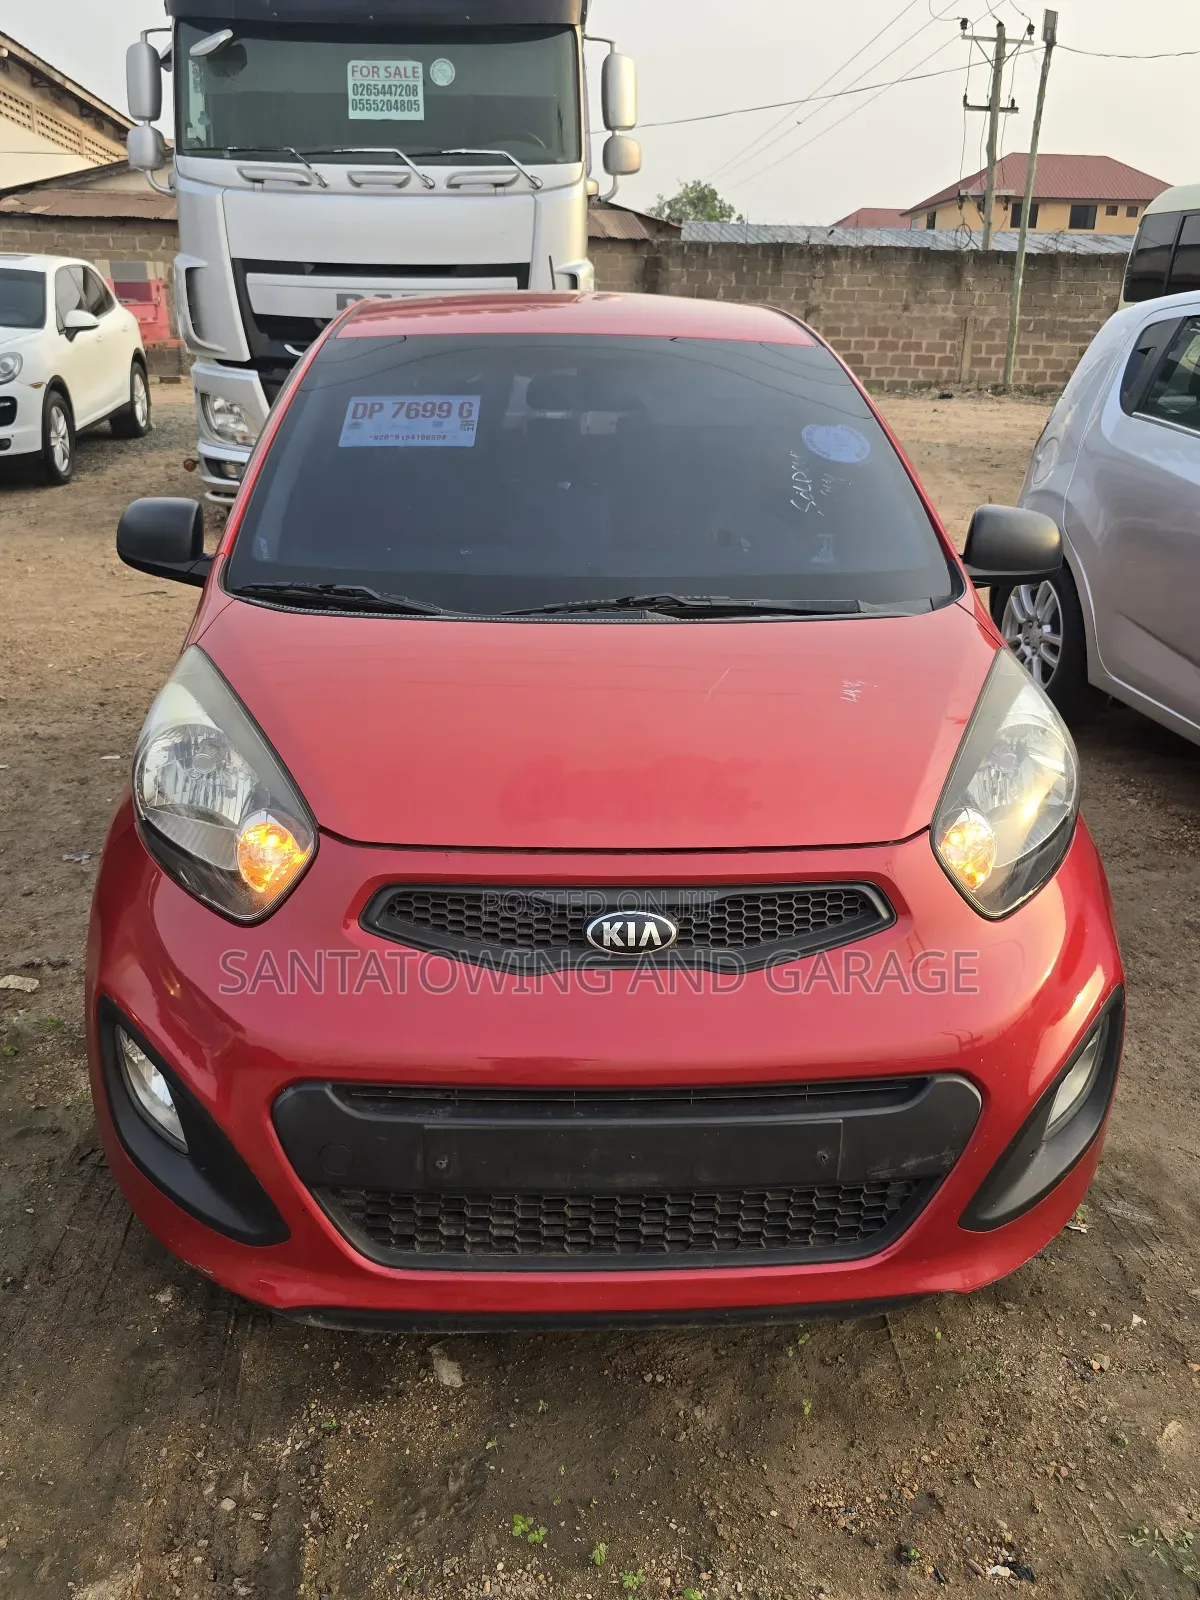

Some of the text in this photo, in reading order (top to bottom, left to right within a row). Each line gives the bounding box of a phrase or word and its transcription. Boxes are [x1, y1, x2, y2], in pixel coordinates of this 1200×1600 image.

[351, 65, 380, 79] FOR
[384, 65, 420, 79] SALE
[352, 83, 419, 97] 0265447208
[351, 99, 421, 112] 0555204805
[351, 401, 474, 420] DP 7699 G
[602, 921, 662, 946] KIA
